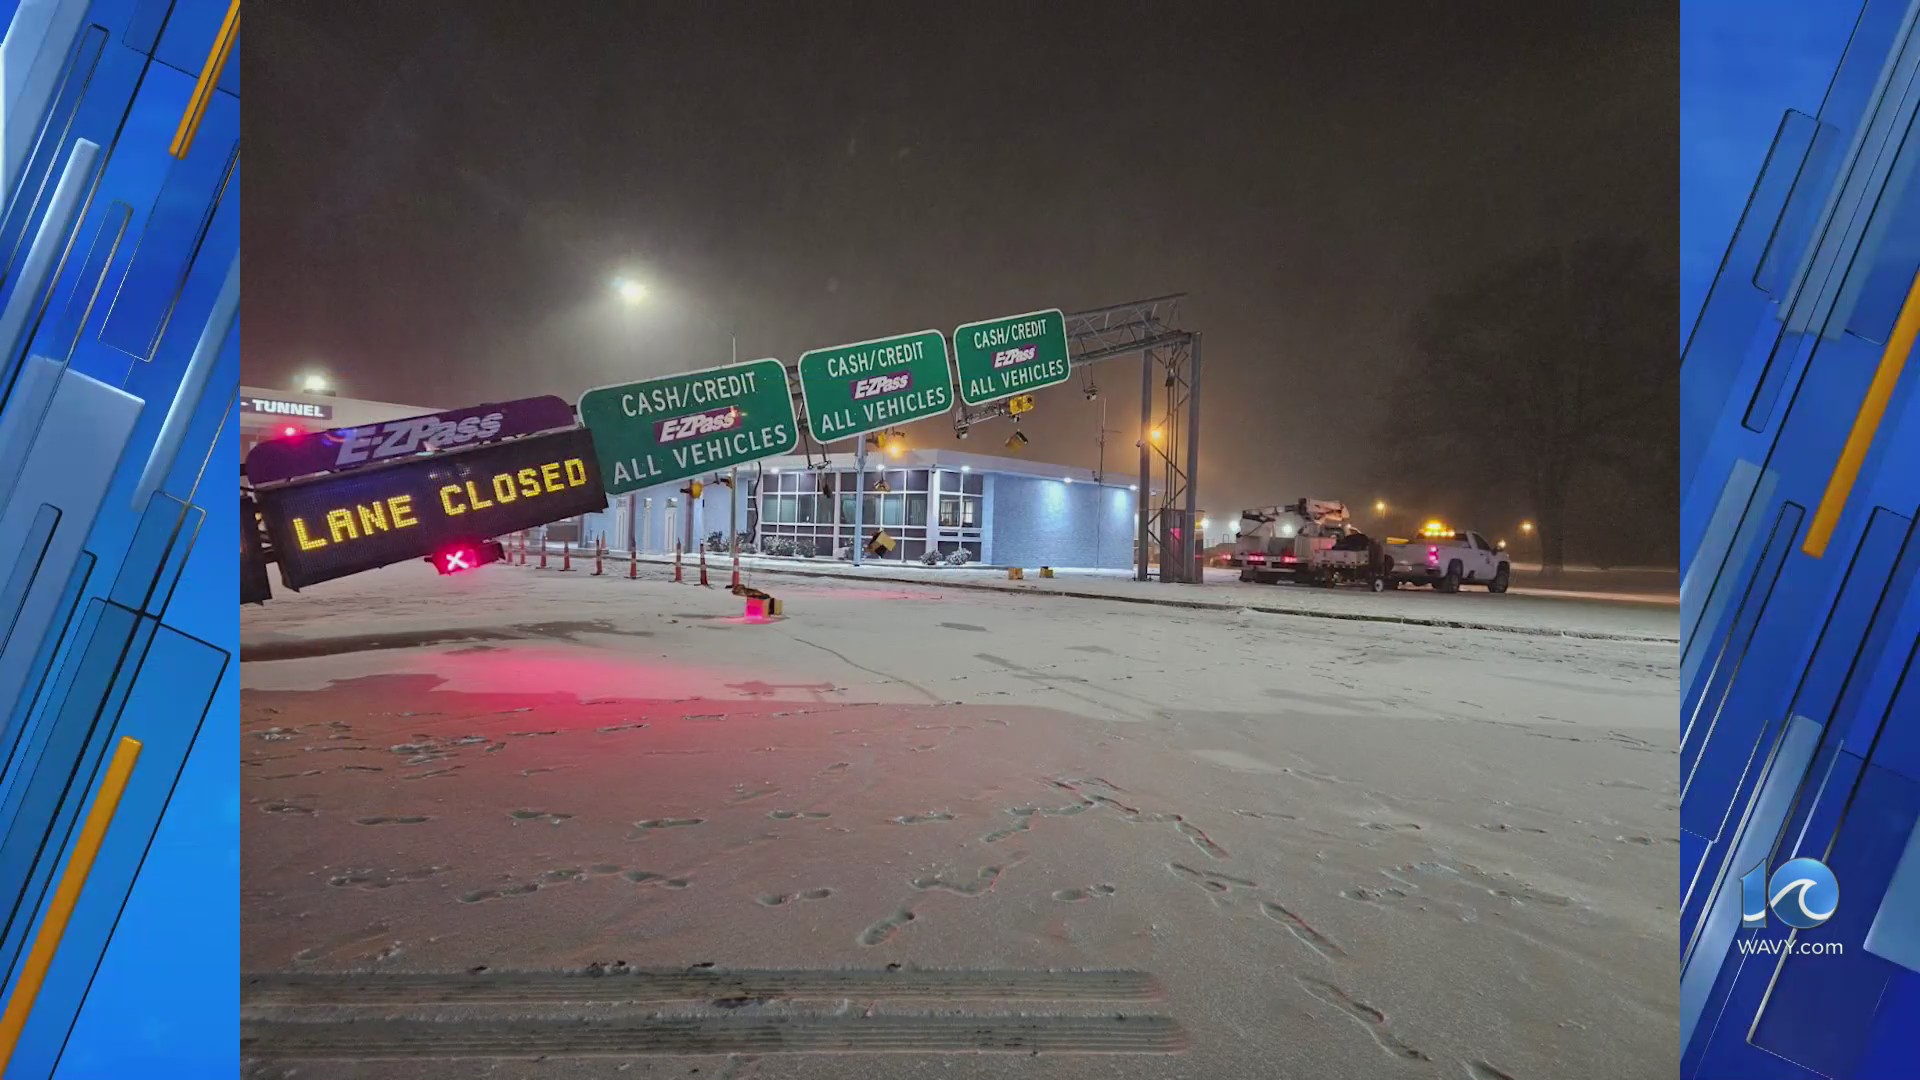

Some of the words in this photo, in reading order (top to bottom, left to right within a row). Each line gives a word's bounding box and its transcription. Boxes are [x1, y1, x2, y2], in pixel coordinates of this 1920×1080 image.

[974, 319, 1047, 349] CASH/CREDIT
[828, 341, 924, 378] CASH/CREDIT
[970, 376, 996, 397] ALL
[1001, 359, 1064, 389] VEHICLES
[252, 398, 325, 418] TUNNEL
[622, 371, 756, 417] CASH/CREDIT
[821, 408, 856, 434] ALL
[863, 387, 946, 423] VEHICLES
[334, 412, 503, 467] E-ZPass
[613, 454, 662, 486] ALL
[672, 424, 788, 469] VEHICLES
[293, 495, 418, 551] LANE
[439, 458, 588, 516] CLOSED
